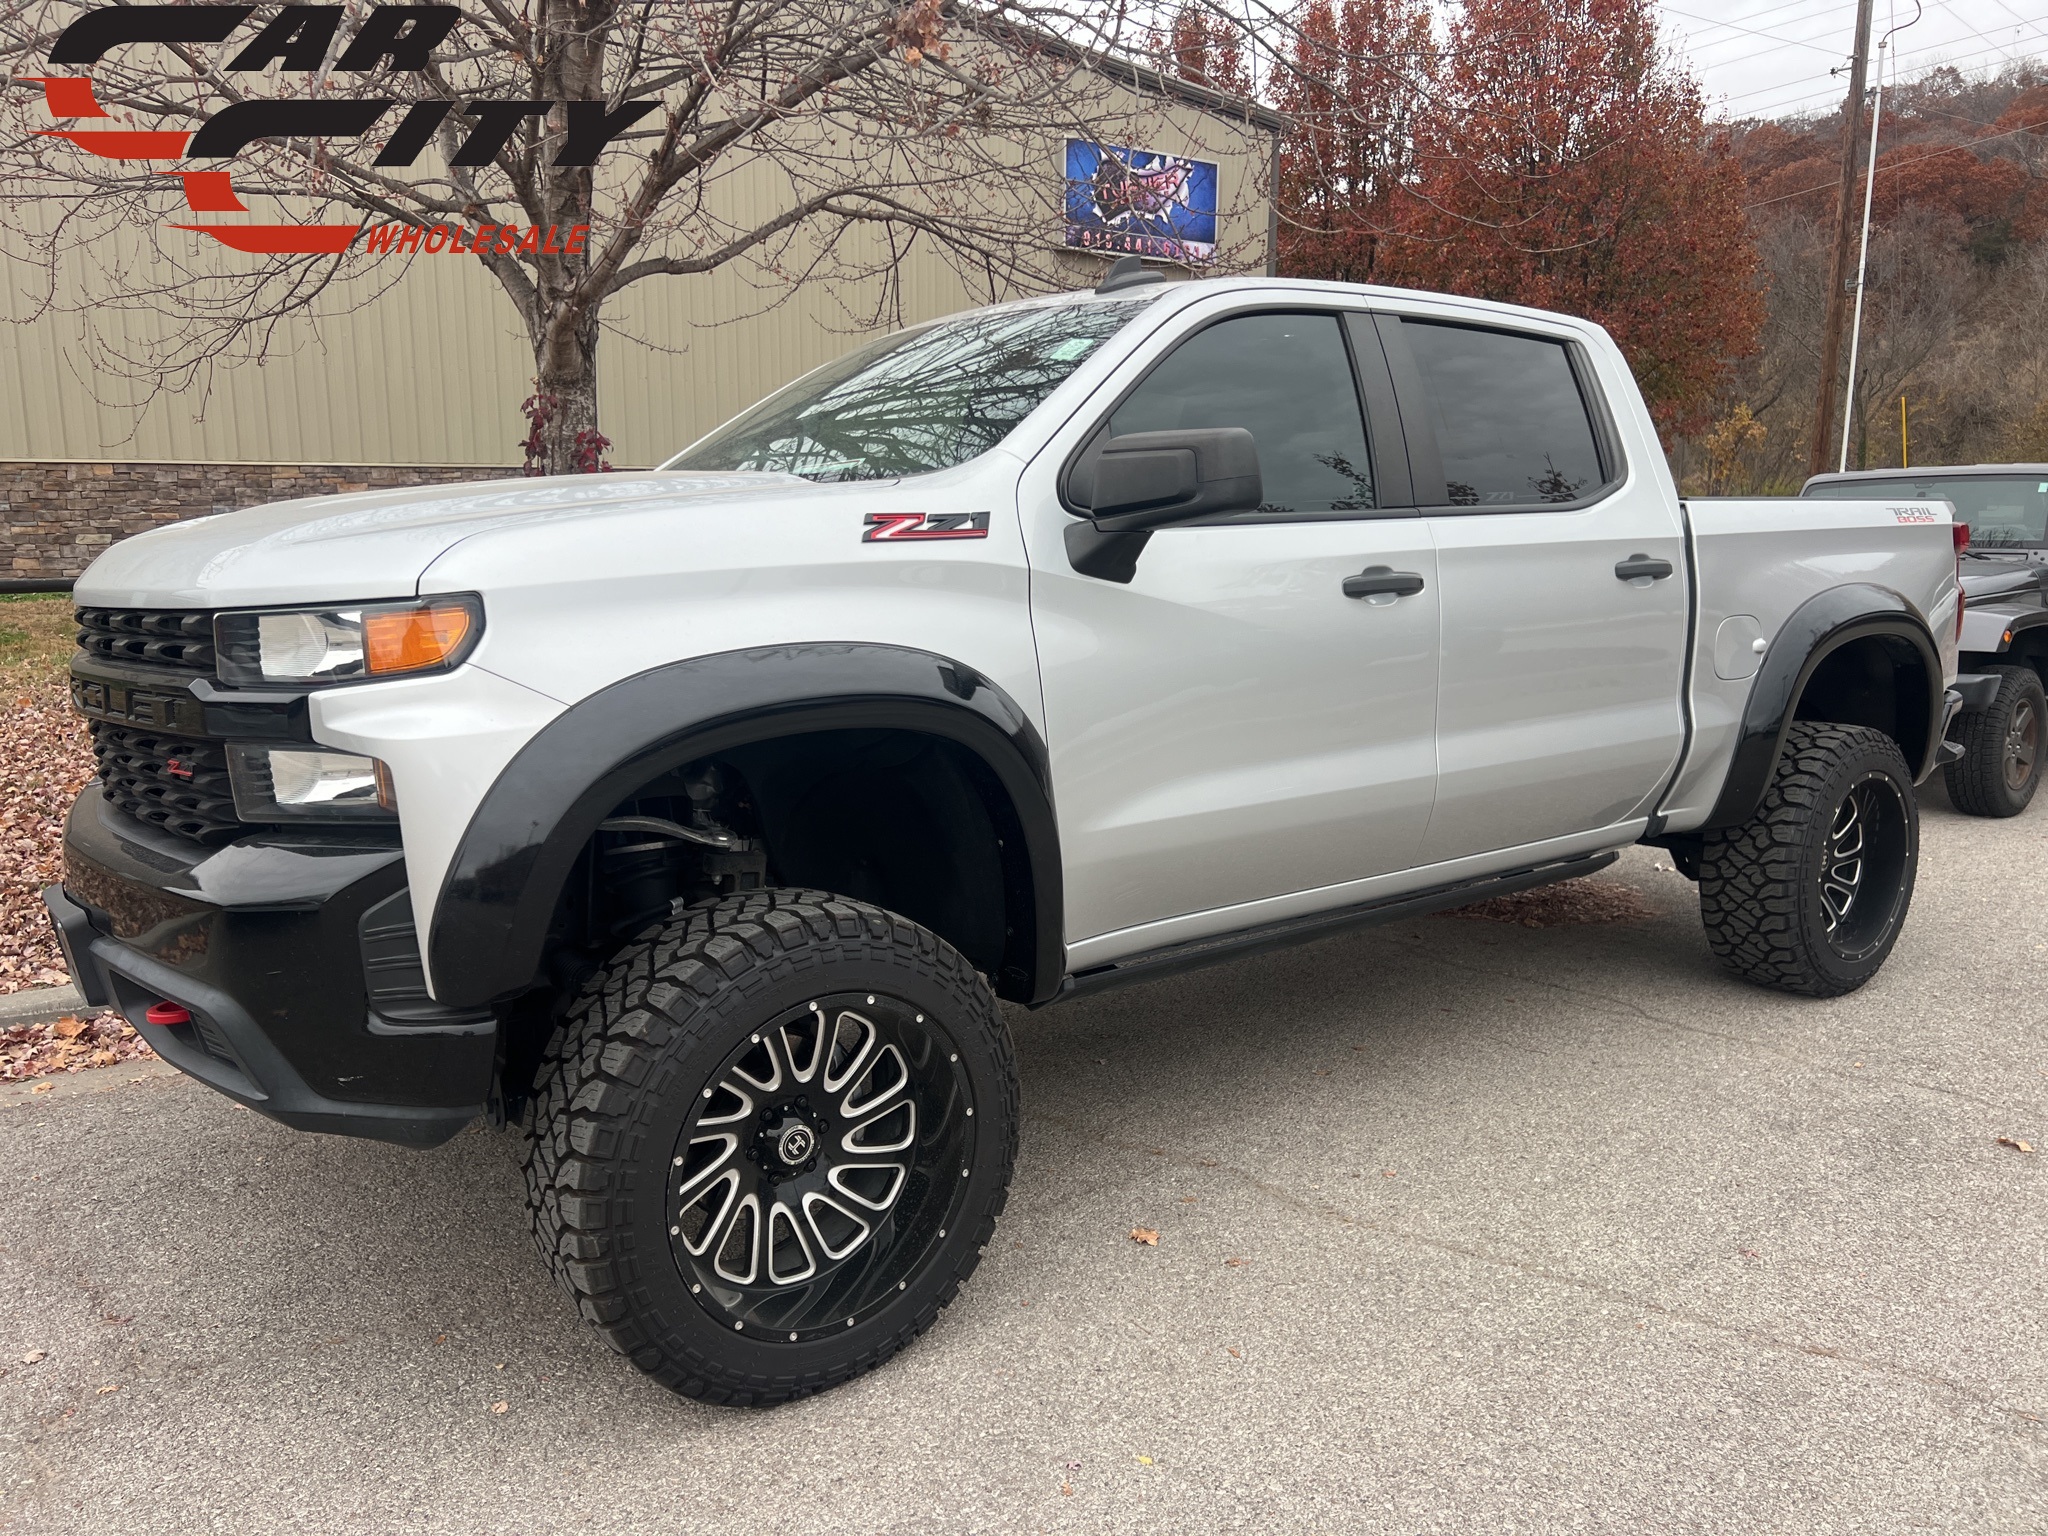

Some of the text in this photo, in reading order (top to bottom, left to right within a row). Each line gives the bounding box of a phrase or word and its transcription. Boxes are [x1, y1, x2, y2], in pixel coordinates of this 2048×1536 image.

[1885, 507, 1938, 516] TRAIL
[1897, 515, 1935, 523] BOSS
[862, 511, 991, 543] Z71
